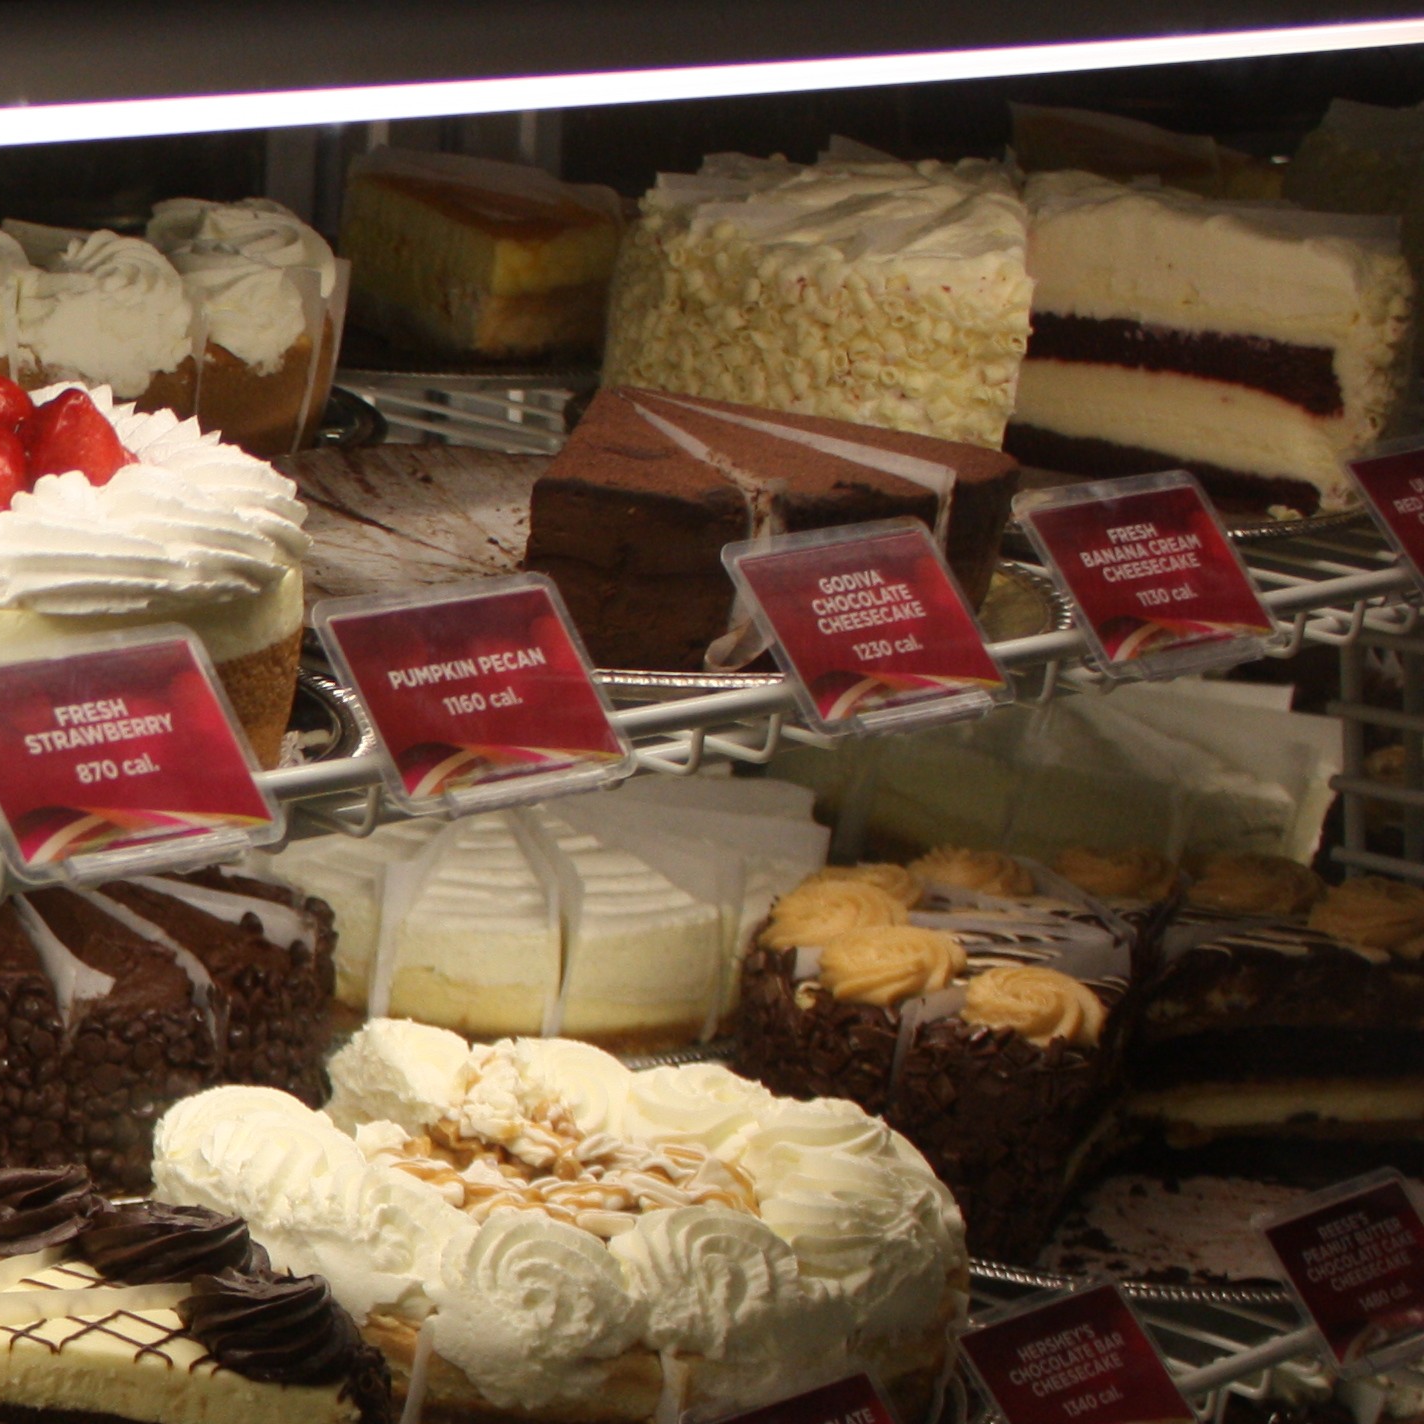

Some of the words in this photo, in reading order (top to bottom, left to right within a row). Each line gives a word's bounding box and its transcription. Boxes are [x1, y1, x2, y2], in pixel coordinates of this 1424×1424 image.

[1079, 543, 1147, 568] BANANA
[1147, 533, 1202, 557] CREAM
[1106, 523, 1158, 546] FRESH
[818, 569, 883, 596] GODIVA
[1101, 552, 1200, 584] CHEESECAKE
[812, 583, 912, 615] CHOCOLATE
[1136, 586, 1168, 608] 1130
[1171, 582, 1199, 602] cal.
[818, 600, 926, 635] CHEESECAKE
[852, 639, 892, 661] 1230
[895, 634, 924, 654] cal.
[388, 658, 476, 691] PUMPKIN
[479, 647, 547, 674] PECAN
[54, 698, 128, 726] FRESH
[443, 691, 485, 716] 1160
[489, 685, 523, 707] cal.
[24, 713, 174, 757] STRAWBERRY
[75, 758, 119, 784] 870
[124, 753, 160, 776] cal.
[1009, 1344, 1092, 1386] CHOCOLATE
[1094, 1332, 1125, 1355] BAR
[1017, 1324, 1095, 1363] HERSHEY'S
[1032, 1353, 1123, 1397] CHEESECAKE
[1062, 1396, 1097, 1417] 1340
[1100, 1385, 1124, 1405] cal.
